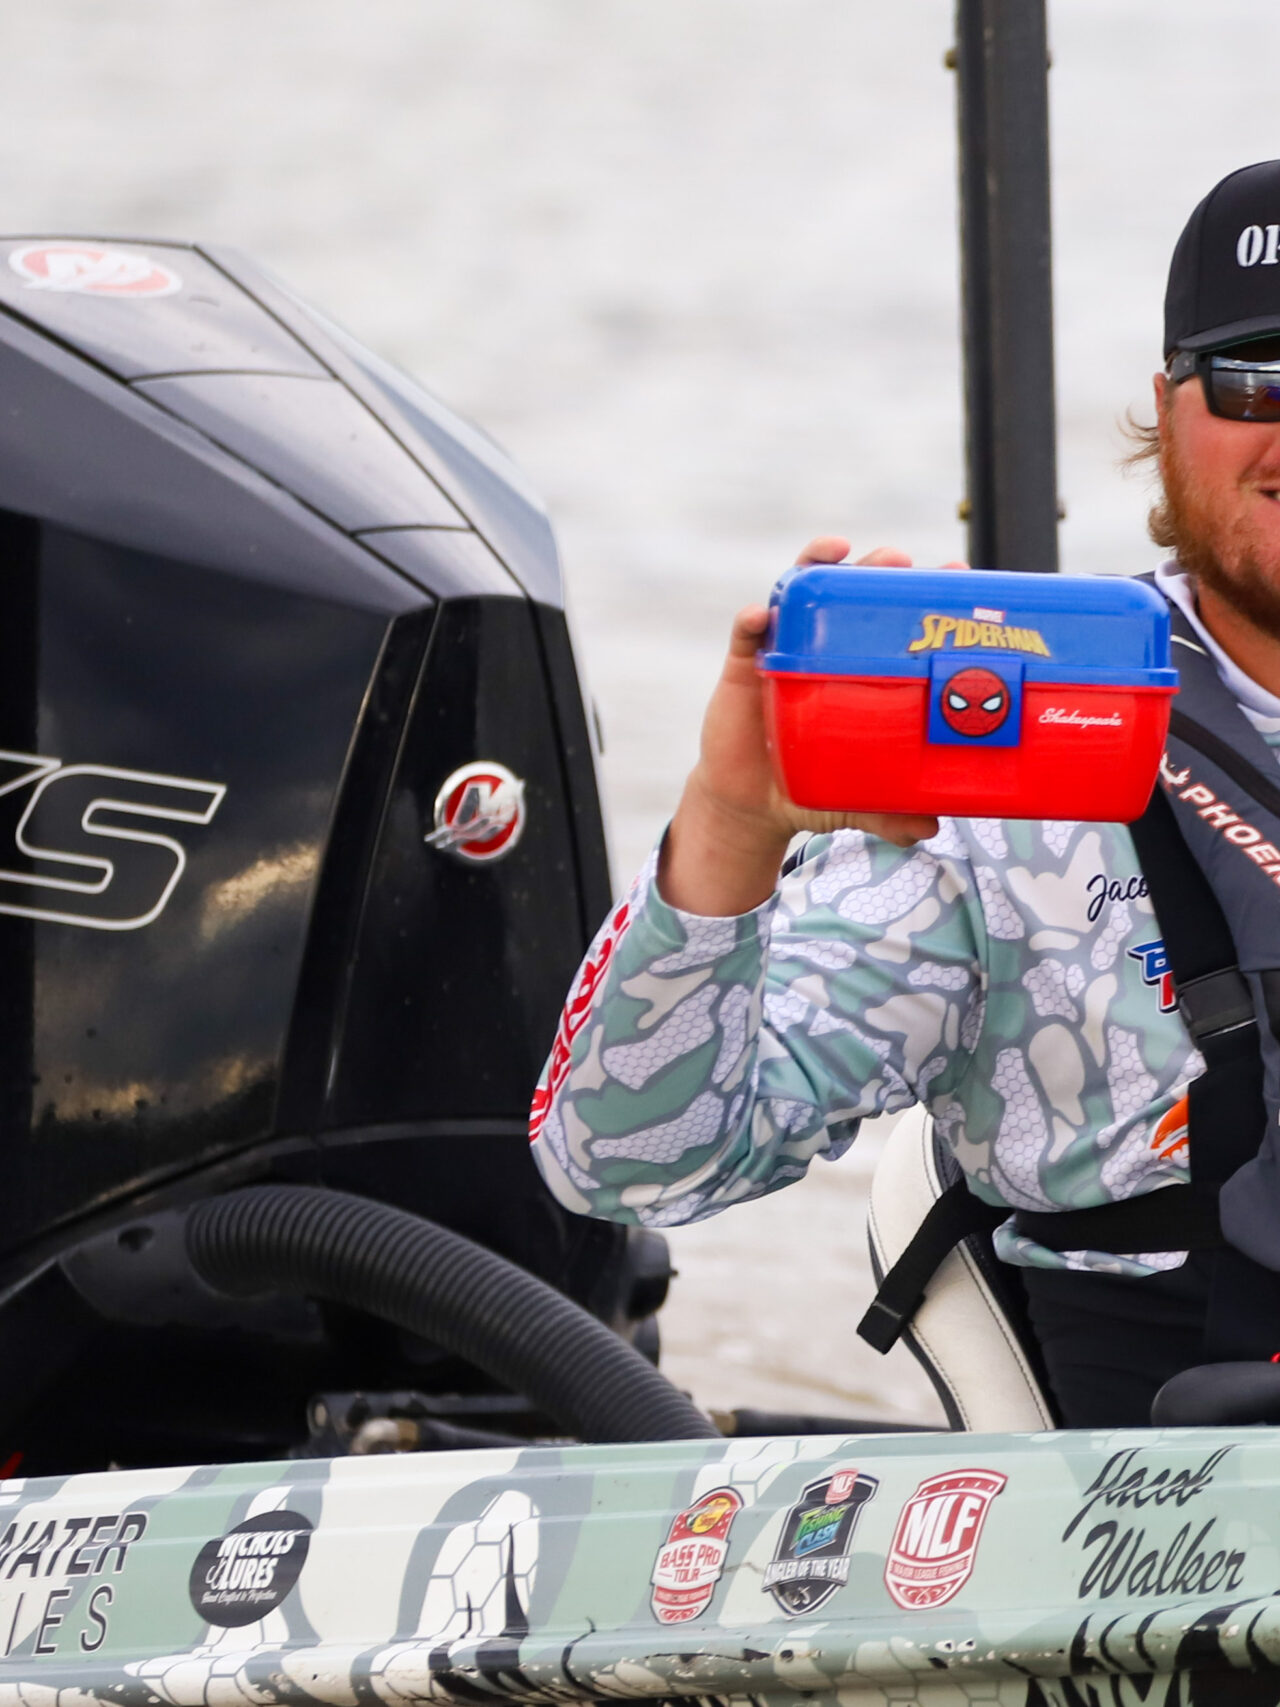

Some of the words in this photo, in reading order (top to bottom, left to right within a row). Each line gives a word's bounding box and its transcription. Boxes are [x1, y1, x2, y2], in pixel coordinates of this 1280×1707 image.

[908, 614, 1051, 658] SPIDER-MAN
[1086, 874, 1149, 922] Jaco
[1062, 1443, 1243, 1543] Jacob
[216, 1530, 305, 1558] NICHOLS
[898, 1494, 982, 1559] MLF
[206, 1556, 279, 1590] LURES
[660, 1545, 694, 1569] BASS
[697, 1544, 721, 1567] PRO
[674, 1568, 700, 1584] TOUR
[810, 1559, 828, 1577] THE
[1078, 1516, 1246, 1599] Walker
